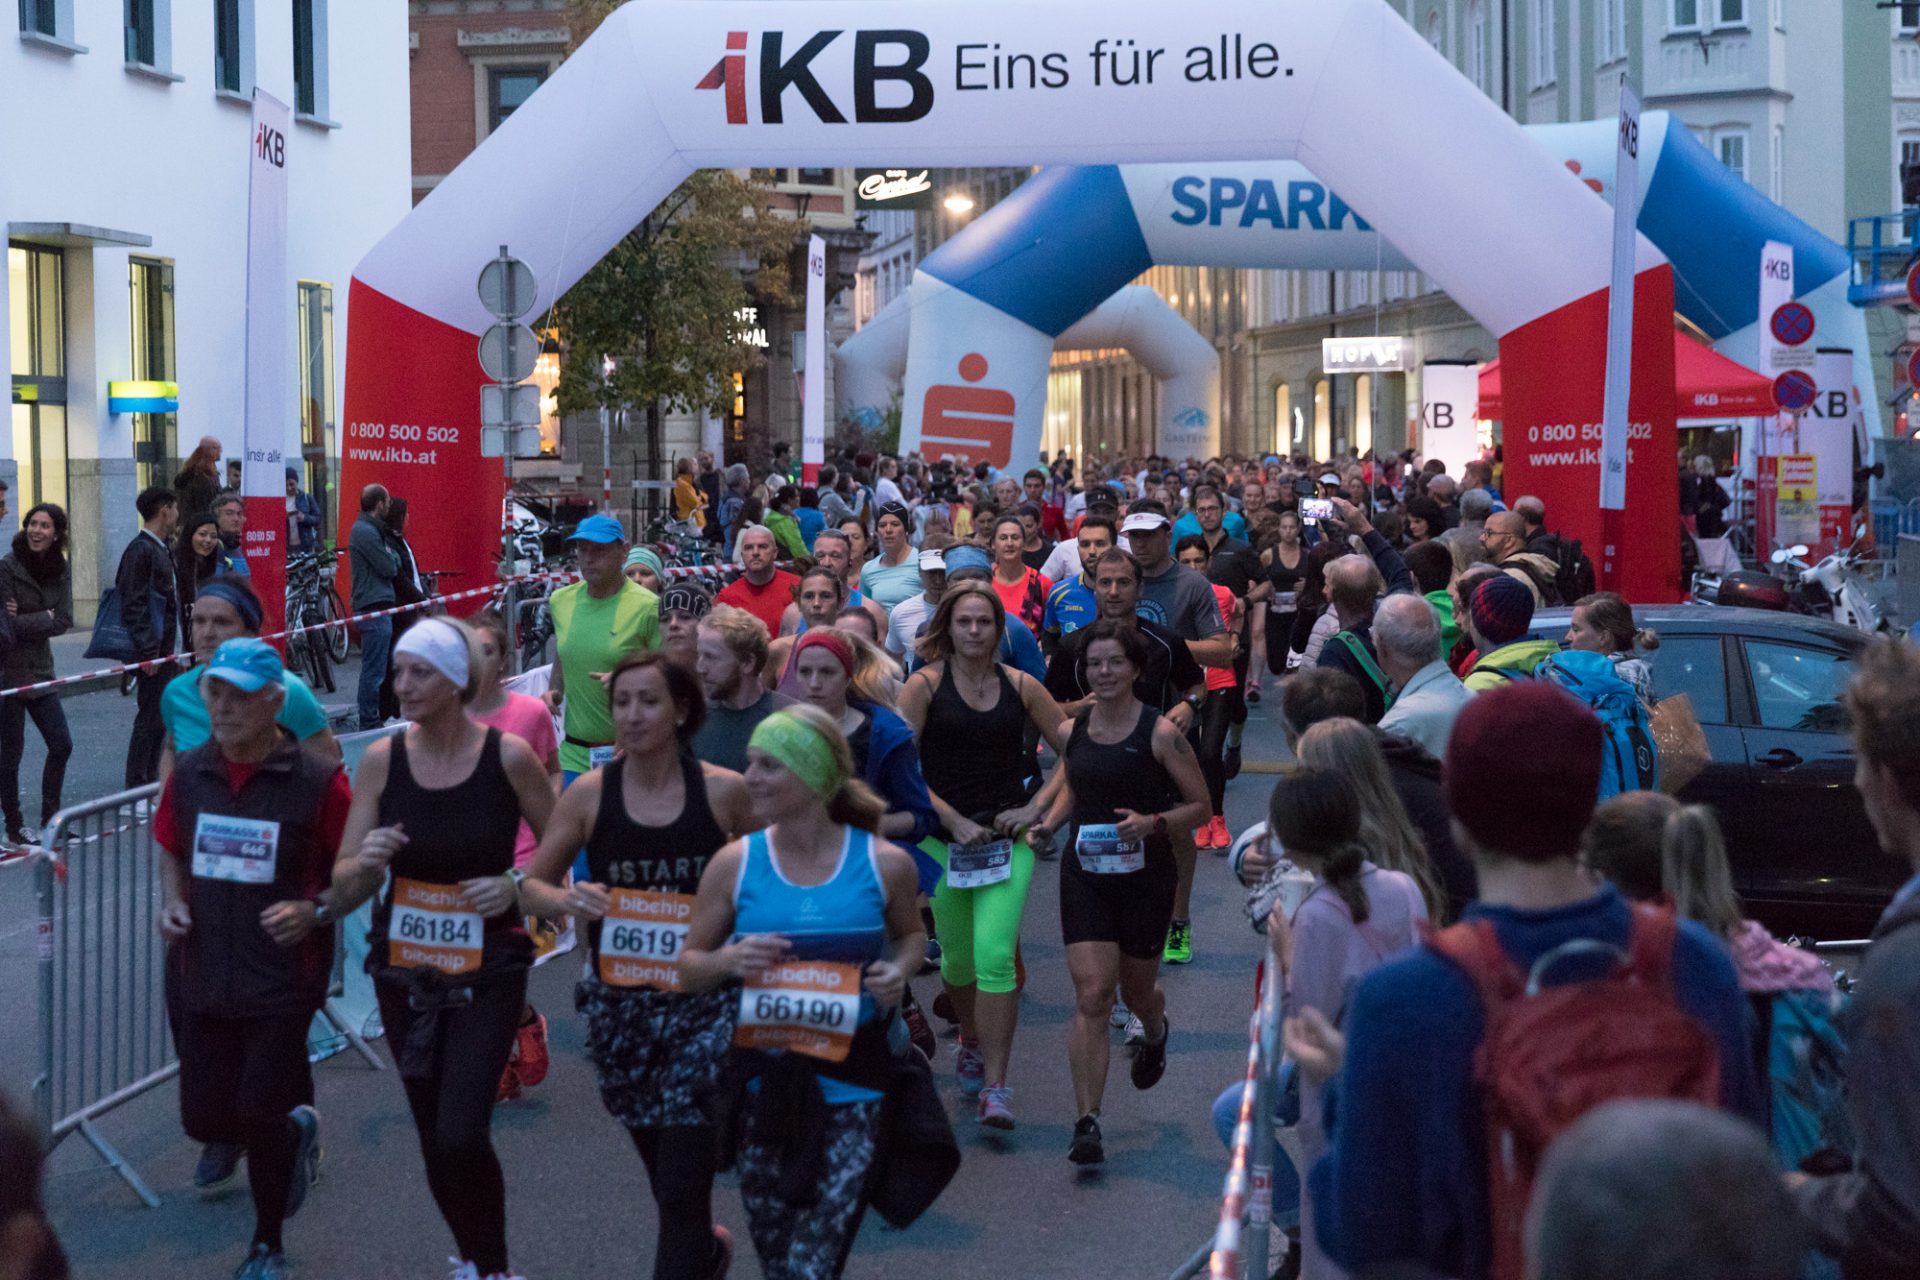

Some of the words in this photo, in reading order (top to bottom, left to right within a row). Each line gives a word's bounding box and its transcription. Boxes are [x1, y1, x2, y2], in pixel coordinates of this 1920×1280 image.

[955, 42, 1070, 90] Eins
[1089, 39, 1166, 87] für
[1184, 33, 1295, 82] alle.
[350, 422, 357, 438] 0
[359, 423, 385, 439] 800
[389, 424, 421, 441] 500
[427, 426, 459, 443] 502
[1528, 426, 1539, 442] 0
[1542, 424, 1576, 441] 800
[1581, 423, 1604, 440] 50
[349, 445, 437, 464] www.ikb.at
[202, 823, 260, 839] SPARKASSE
[241, 842, 266, 856] 646
[988, 855, 1005, 866] 585
[620, 896, 690, 918] bibchip
[400, 913, 471, 943] 66184
[402, 945, 465, 973] bibchip
[761, 965, 842, 988] bibchip
[755, 993, 845, 1028] 66190
